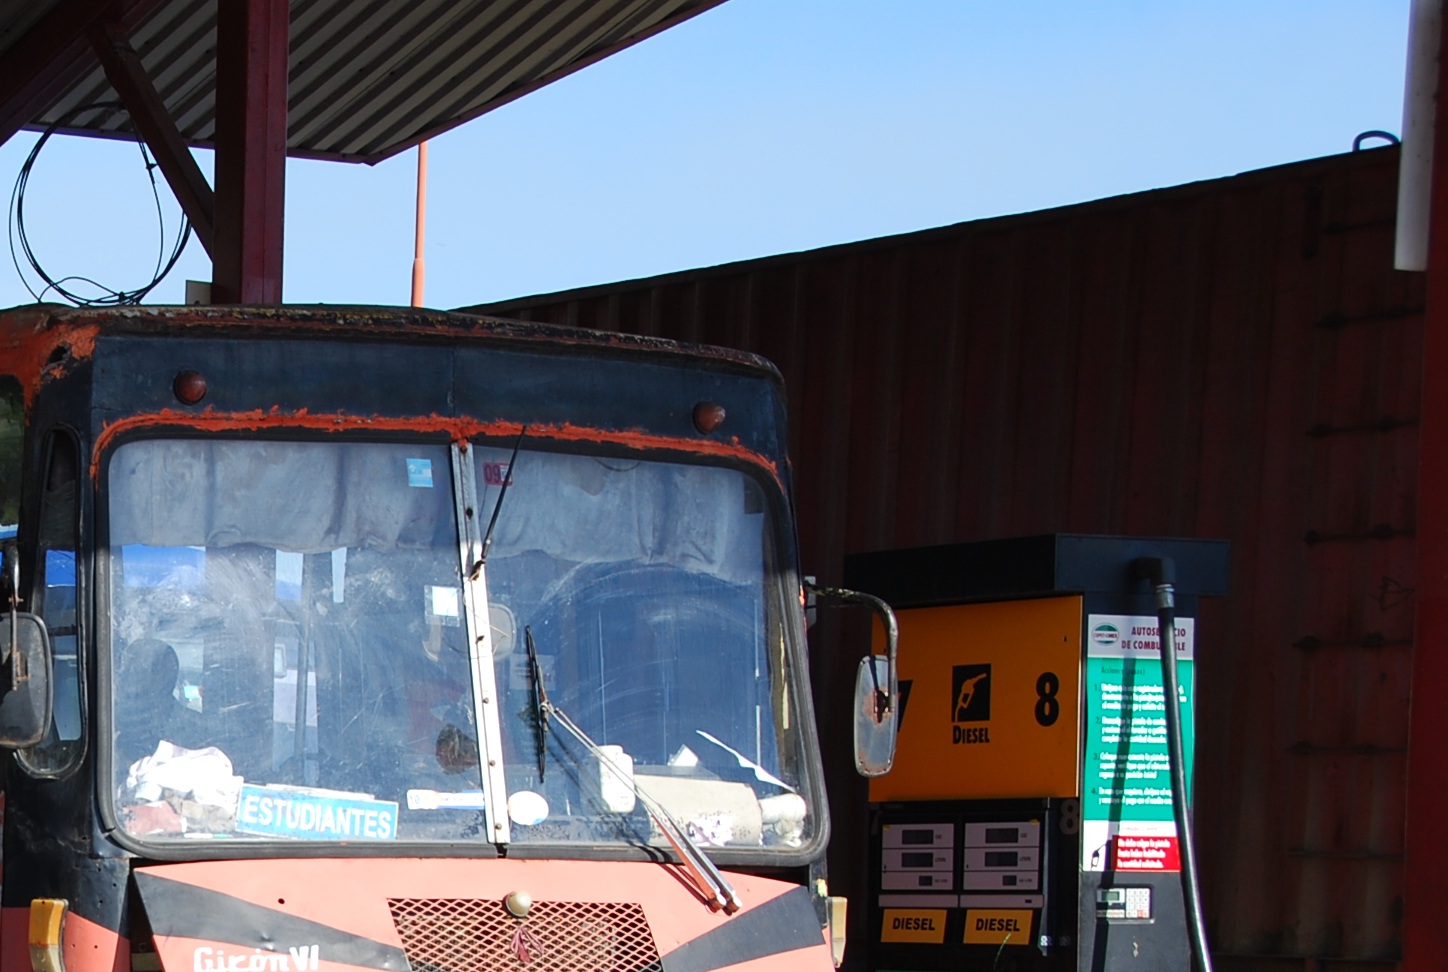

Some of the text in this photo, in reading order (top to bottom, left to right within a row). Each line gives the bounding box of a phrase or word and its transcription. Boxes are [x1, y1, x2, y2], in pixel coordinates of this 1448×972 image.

[1121, 640, 1132, 650] DE
[1035, 672, 1060, 727] 8
[242, 795, 392, 839] ESTUDIANTES
[1060, 799, 1078, 835] 8
[893, 917, 935, 931] DIESEL
[975, 918, 1020, 932] DIESEL
